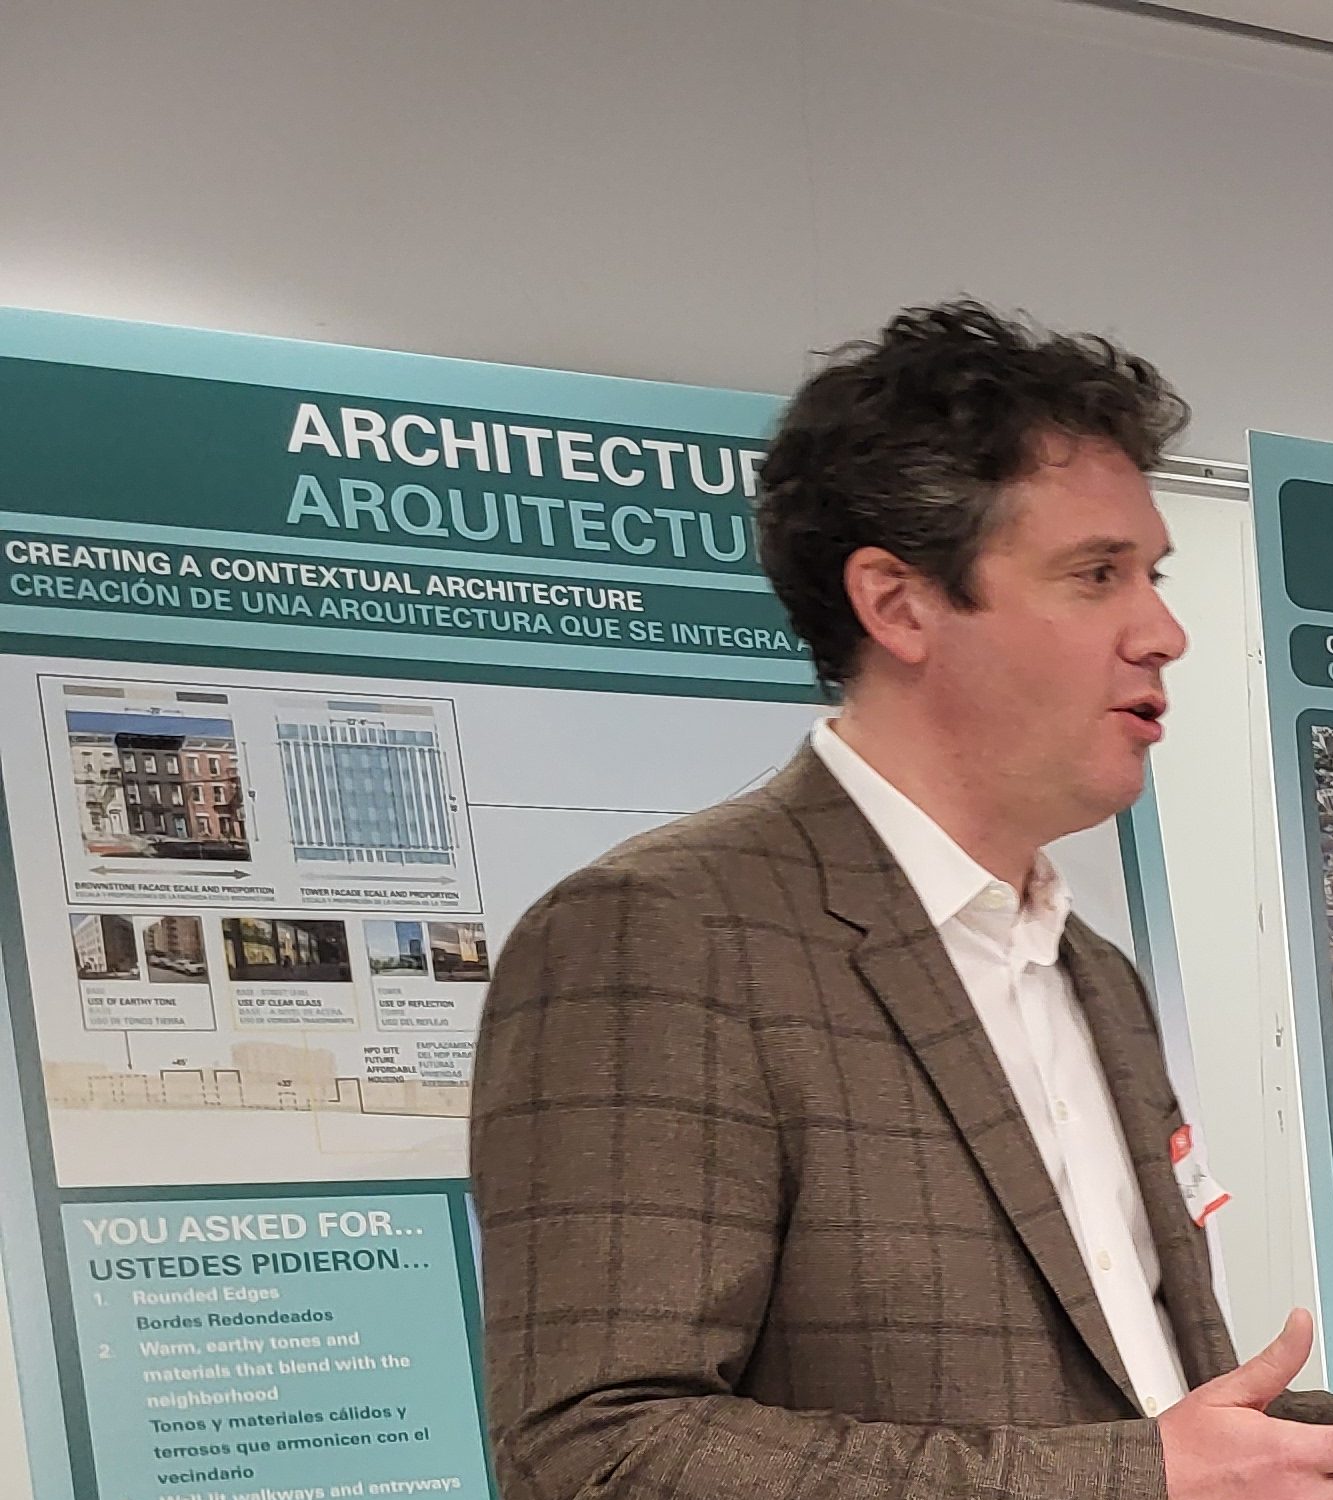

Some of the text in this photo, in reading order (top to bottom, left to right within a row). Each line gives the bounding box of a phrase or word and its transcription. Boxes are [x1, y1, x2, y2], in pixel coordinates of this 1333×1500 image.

[287, 474, 759, 563] ARQUITECTU
[6, 540, 644, 611] CREATING A CONTEXTUAL ARCHITECTURE
[10, 573, 792, 654] CREACIÓN DE UNA ARQUITECTURA QUE SE INTEGRA
[82, 1208, 423, 1245] YOU ASKED FOR...
[89, 1248, 429, 1281] USTEDES PIDIERON...
[132, 1287, 220, 1305] Rounded
[220, 1286, 282, 1303] Edges
[136, 1308, 333, 1330] Bordes Redondeados
[206, 1336, 265, 1353] earthy
[269, 1336, 321, 1349] tones
[326, 1331, 361, 1346] and
[148, 1405, 406, 1433] Tonos y materiales cálidos y
